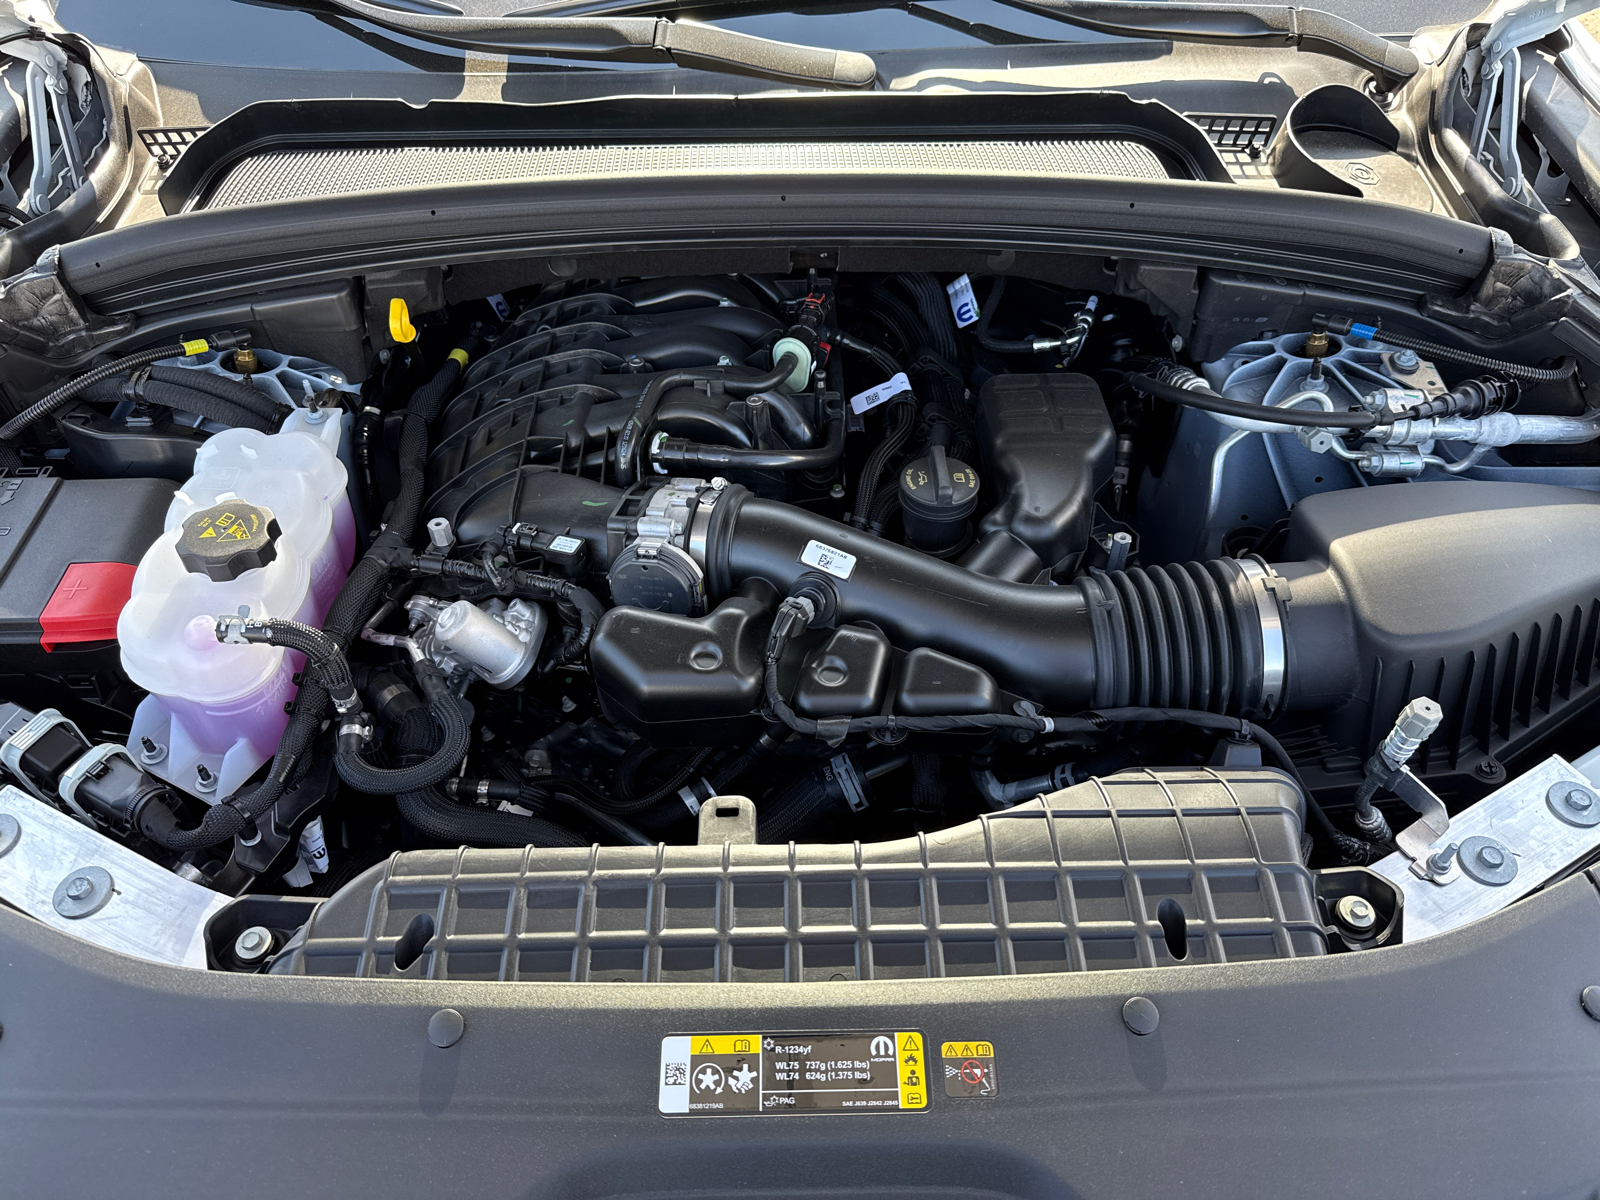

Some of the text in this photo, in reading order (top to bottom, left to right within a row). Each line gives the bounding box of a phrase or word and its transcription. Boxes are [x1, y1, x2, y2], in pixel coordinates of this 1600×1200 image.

[823, 765, 834, 782] ENG
[775, 1045, 812, 1055] R-1234yf
[775, 1060, 870, 1070] WL75 737g (1.625 lbs)
[775, 1071, 871, 1081] WL74 624g (1.375 lbs)
[780, 1097, 796, 1105] PAG
